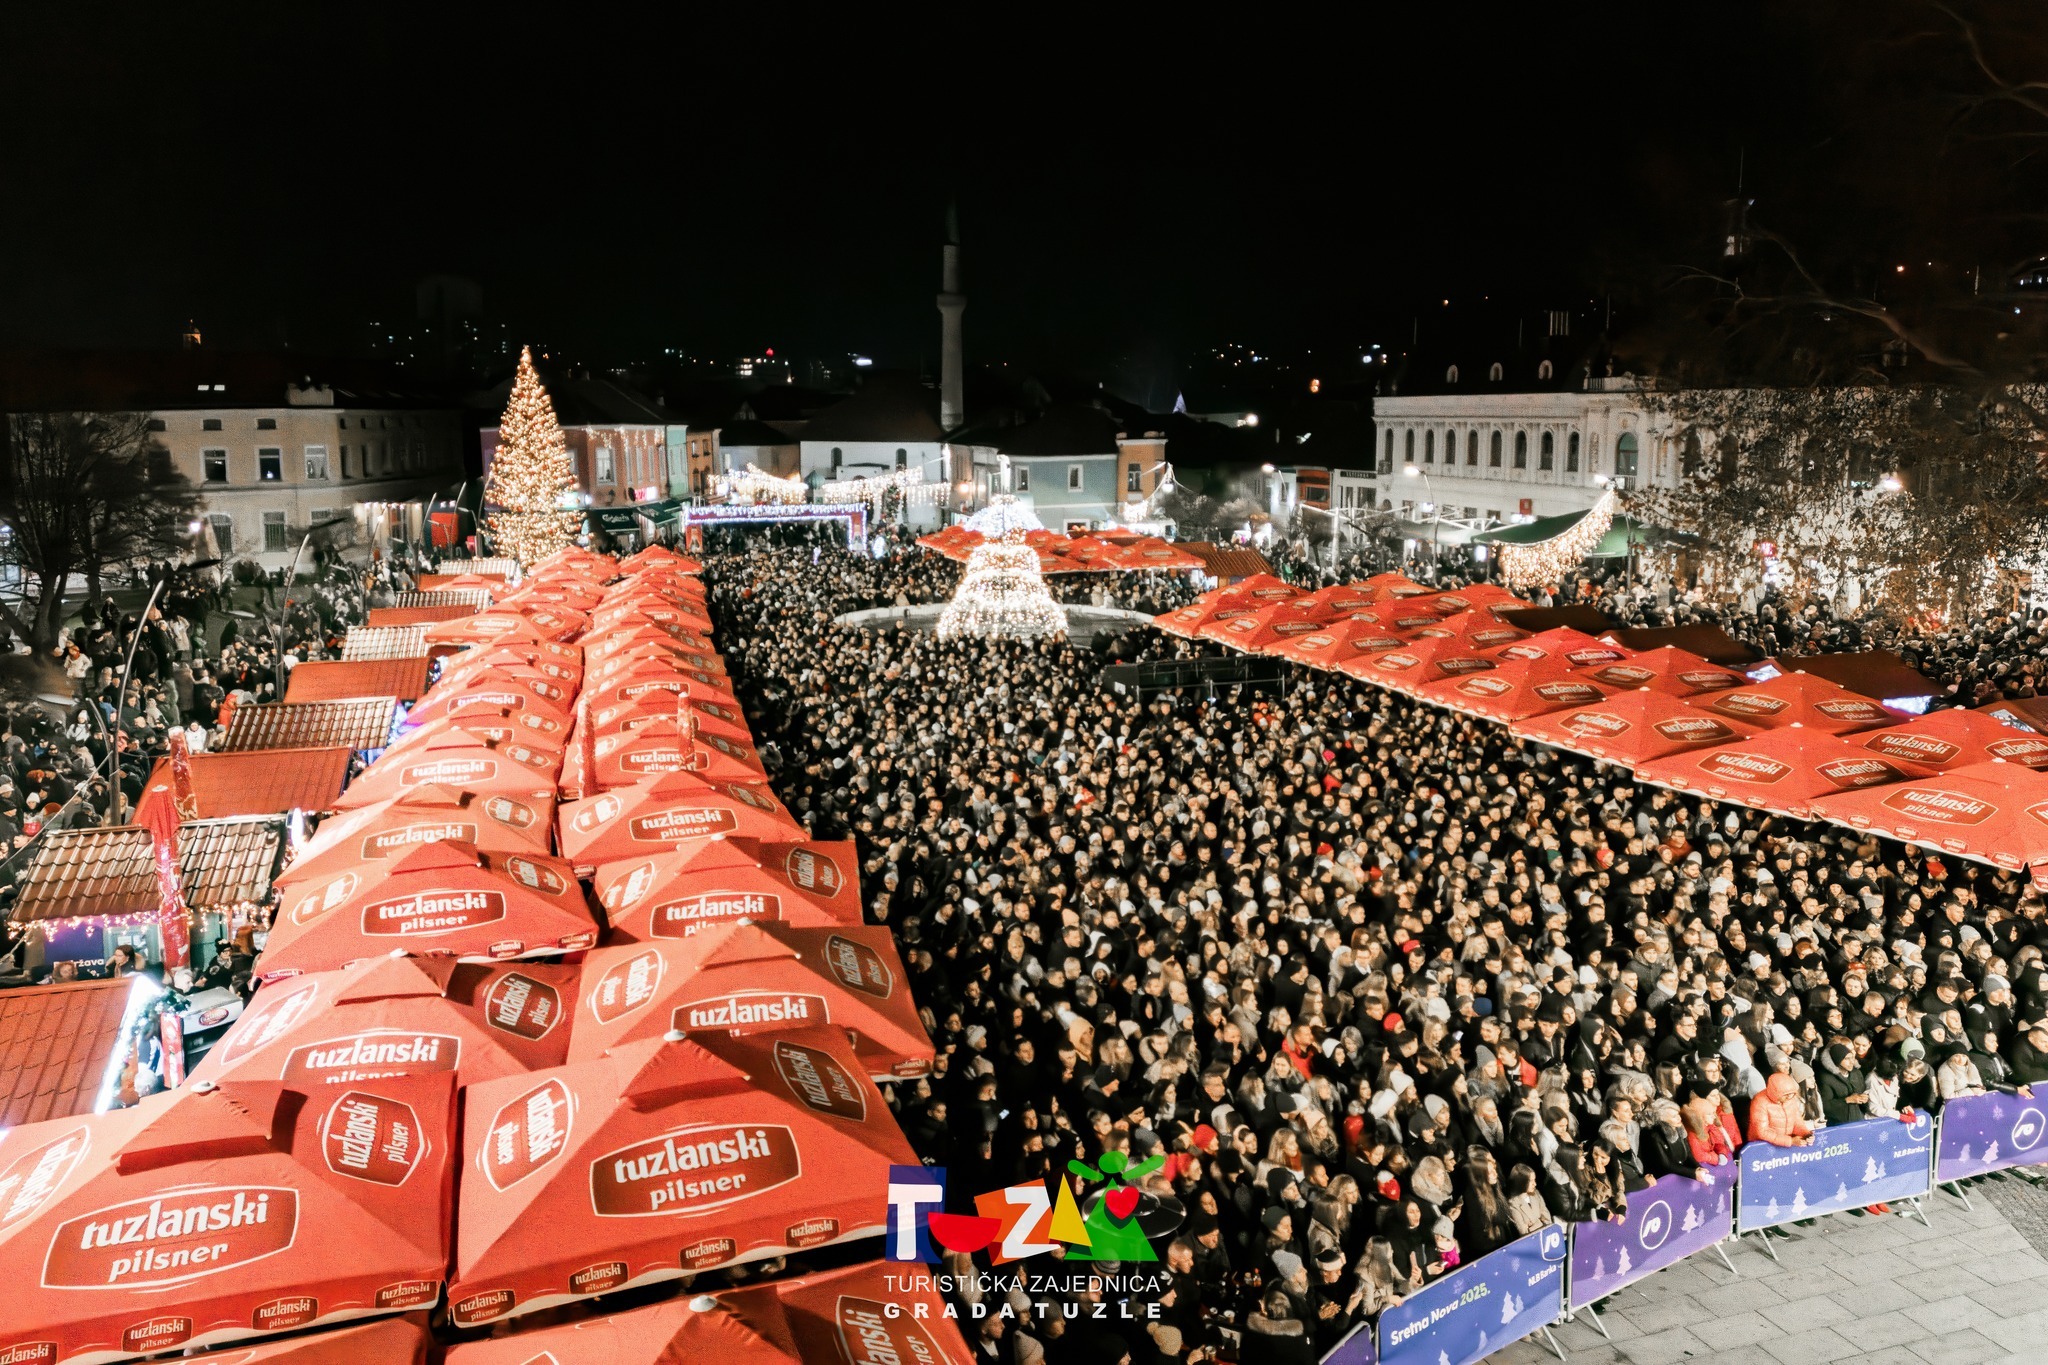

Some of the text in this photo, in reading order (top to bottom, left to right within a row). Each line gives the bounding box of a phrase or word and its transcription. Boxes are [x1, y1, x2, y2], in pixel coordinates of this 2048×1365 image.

[1882, 735, 1950, 755] tuzlanski
[1716, 754, 1783, 775] tuzlanski
[1903, 804, 1954, 820] pilsner
[1904, 792, 1986, 815] tuzlanski
[642, 810, 722, 830] tuzlanski
[379, 892, 487, 920] tuzlanski
[666, 896, 765, 921] tuzlanski
[400, 914, 468, 934] pilsner
[496, 977, 532, 1026] tuzlanski
[690, 996, 808, 1028] tuzlanski
[306, 1036, 440, 1070] tuzlanski
[781, 1048, 832, 1107] tuzlanski
[330, 1100, 378, 1169] tuzlanski
[527, 1088, 565, 1163] tuzlanski
[382, 1122, 410, 1166] pilsner
[614, 1129, 772, 1183] tuzlanski
[1752, 1156, 1790, 1172] Sretna
[1792, 1152, 1822, 1164] Nova
[650, 1174, 746, 1210] pilsner
[80, 1192, 268, 1250] tuzlanski
[790, 1219, 832, 1238] tuzlanski
[686, 1239, 730, 1259] tuzlanski
[108, 1243, 228, 1282] pilsner
[576, 1264, 621, 1286] tuzlanski
[260, 1298, 310, 1318] tuzlanski
[460, 1292, 508, 1312] tuzlanski
[1390, 1282, 1490, 1346] Sretna Nova 2025.
[130, 1319, 184, 1340] tuzlanski
